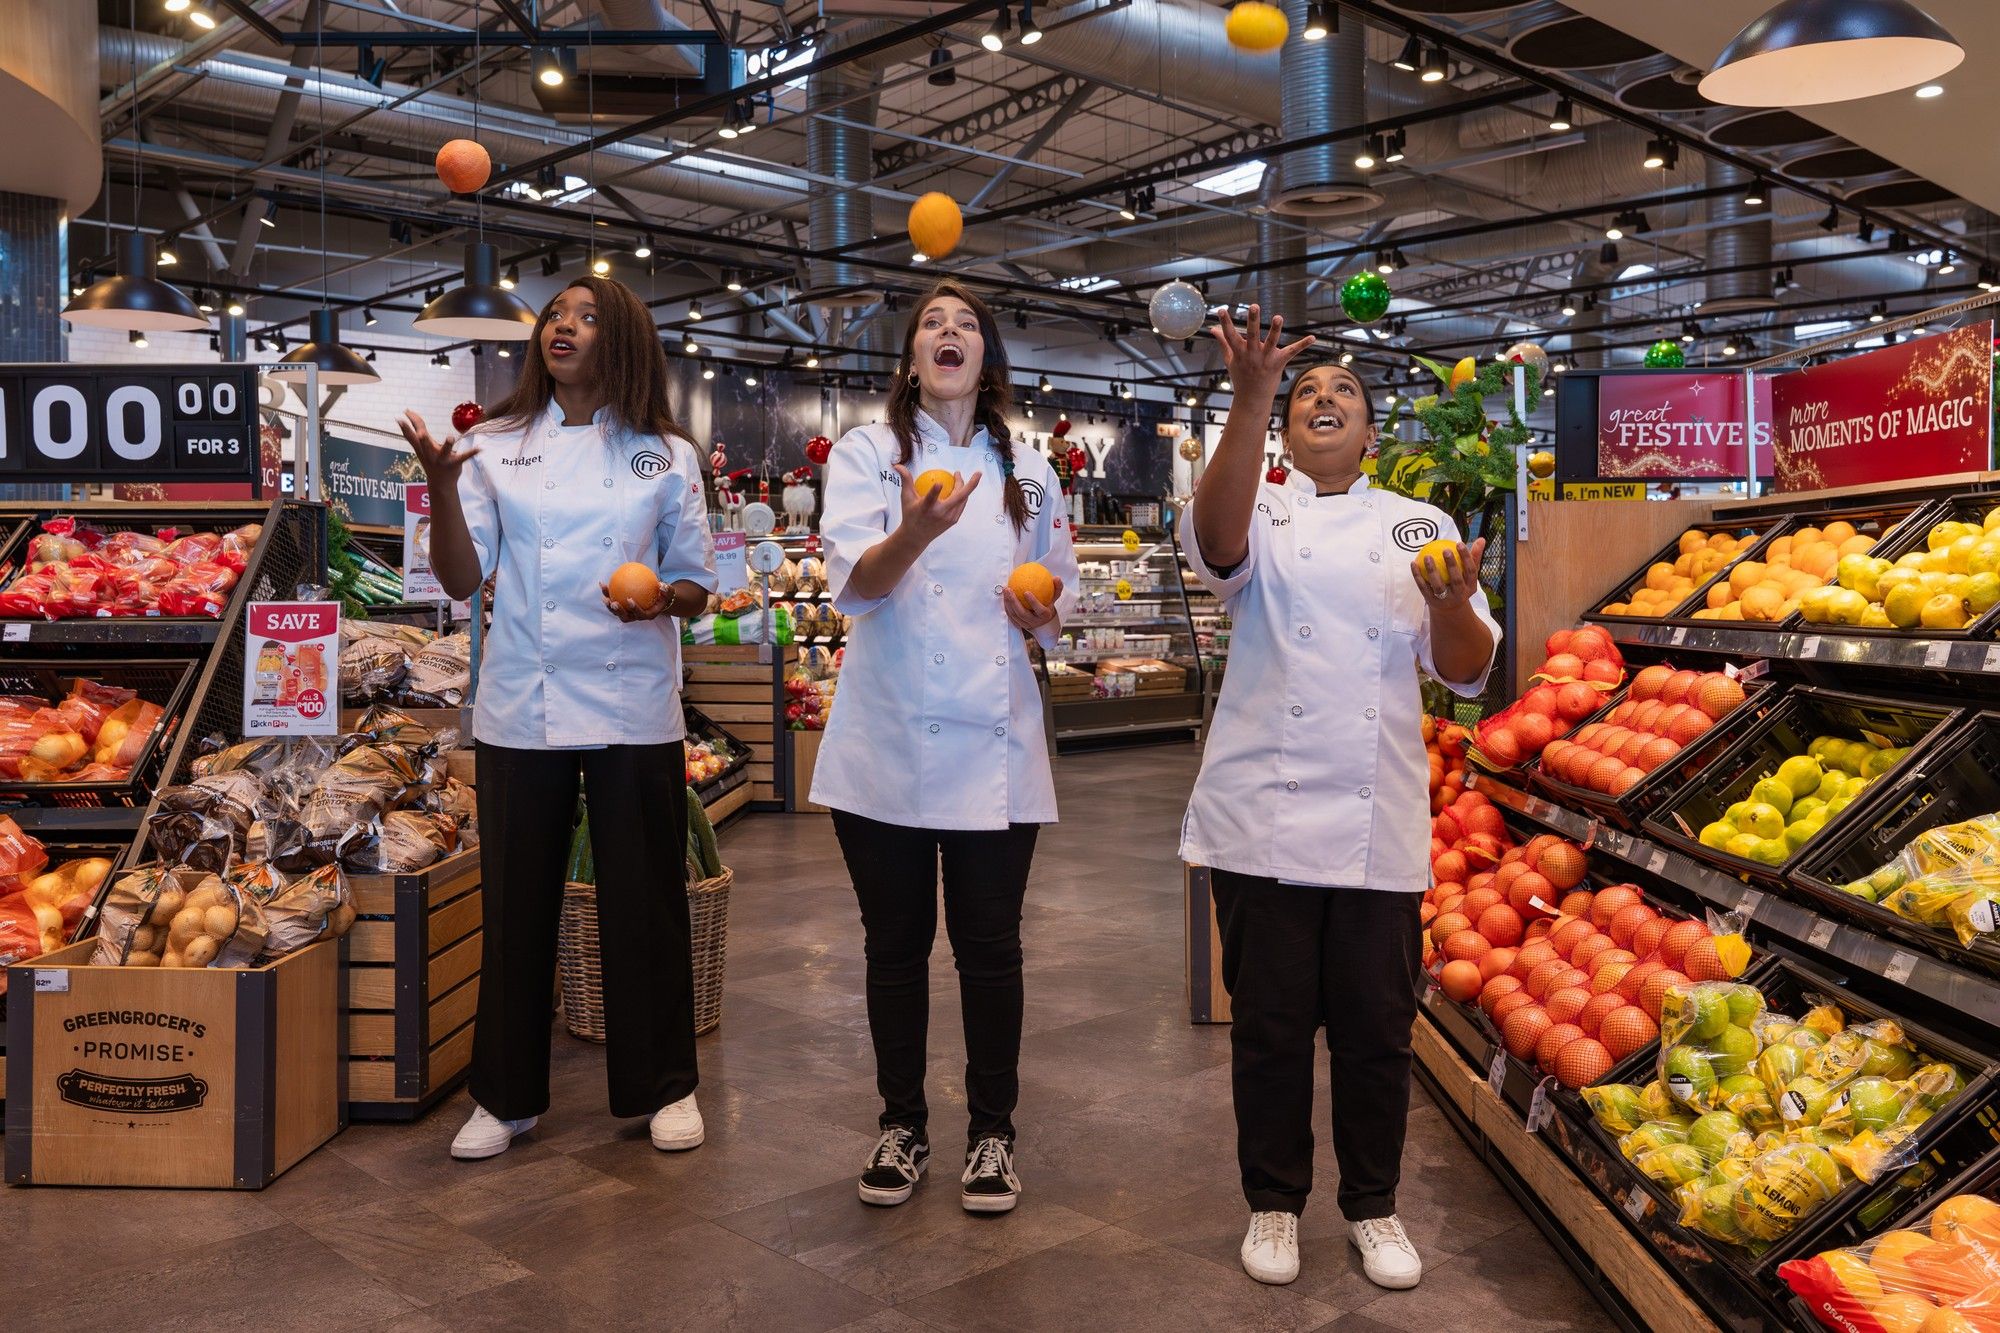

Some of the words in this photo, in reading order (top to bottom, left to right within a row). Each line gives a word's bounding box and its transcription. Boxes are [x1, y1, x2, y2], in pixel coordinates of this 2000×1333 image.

[1604, 400, 1672, 433] great
[1789, 400, 1830, 426] more
[1790, 414, 1874, 453] MOMENTS
[1878, 409, 1903, 440] OF
[1906, 396, 1974, 436] MAGIC
[1618, 421, 1743, 447] FESTIVE
[187, 438, 224, 456] FOR
[227, 438, 240, 454] 3
[500, 454, 543, 467] Bridget
[332, 472, 379, 498] FESTIVE
[879, 470, 902, 488] Nabi
[1563, 490, 1577, 500] e,
[1603, 485, 1636, 498] NEW
[266, 613, 320, 630] SAVE
[419, 659, 457, 676] POTATOES
[431, 655, 466, 674] PURPOSE
[63, 1010, 207, 1039] GREENGROCER'S
[83, 1041, 184, 1062] PROMISE
[78, 1079, 144, 1097] PERFECTLY
[146, 1083, 186, 1097] FRESH
[88, 1095, 132, 1108] whatever
[133, 1097, 143, 1108] it
[146, 1098, 176, 1109] takes
[1755, 1203, 1765, 1213] IN
[1762, 1184, 1801, 1216] LEMONS
